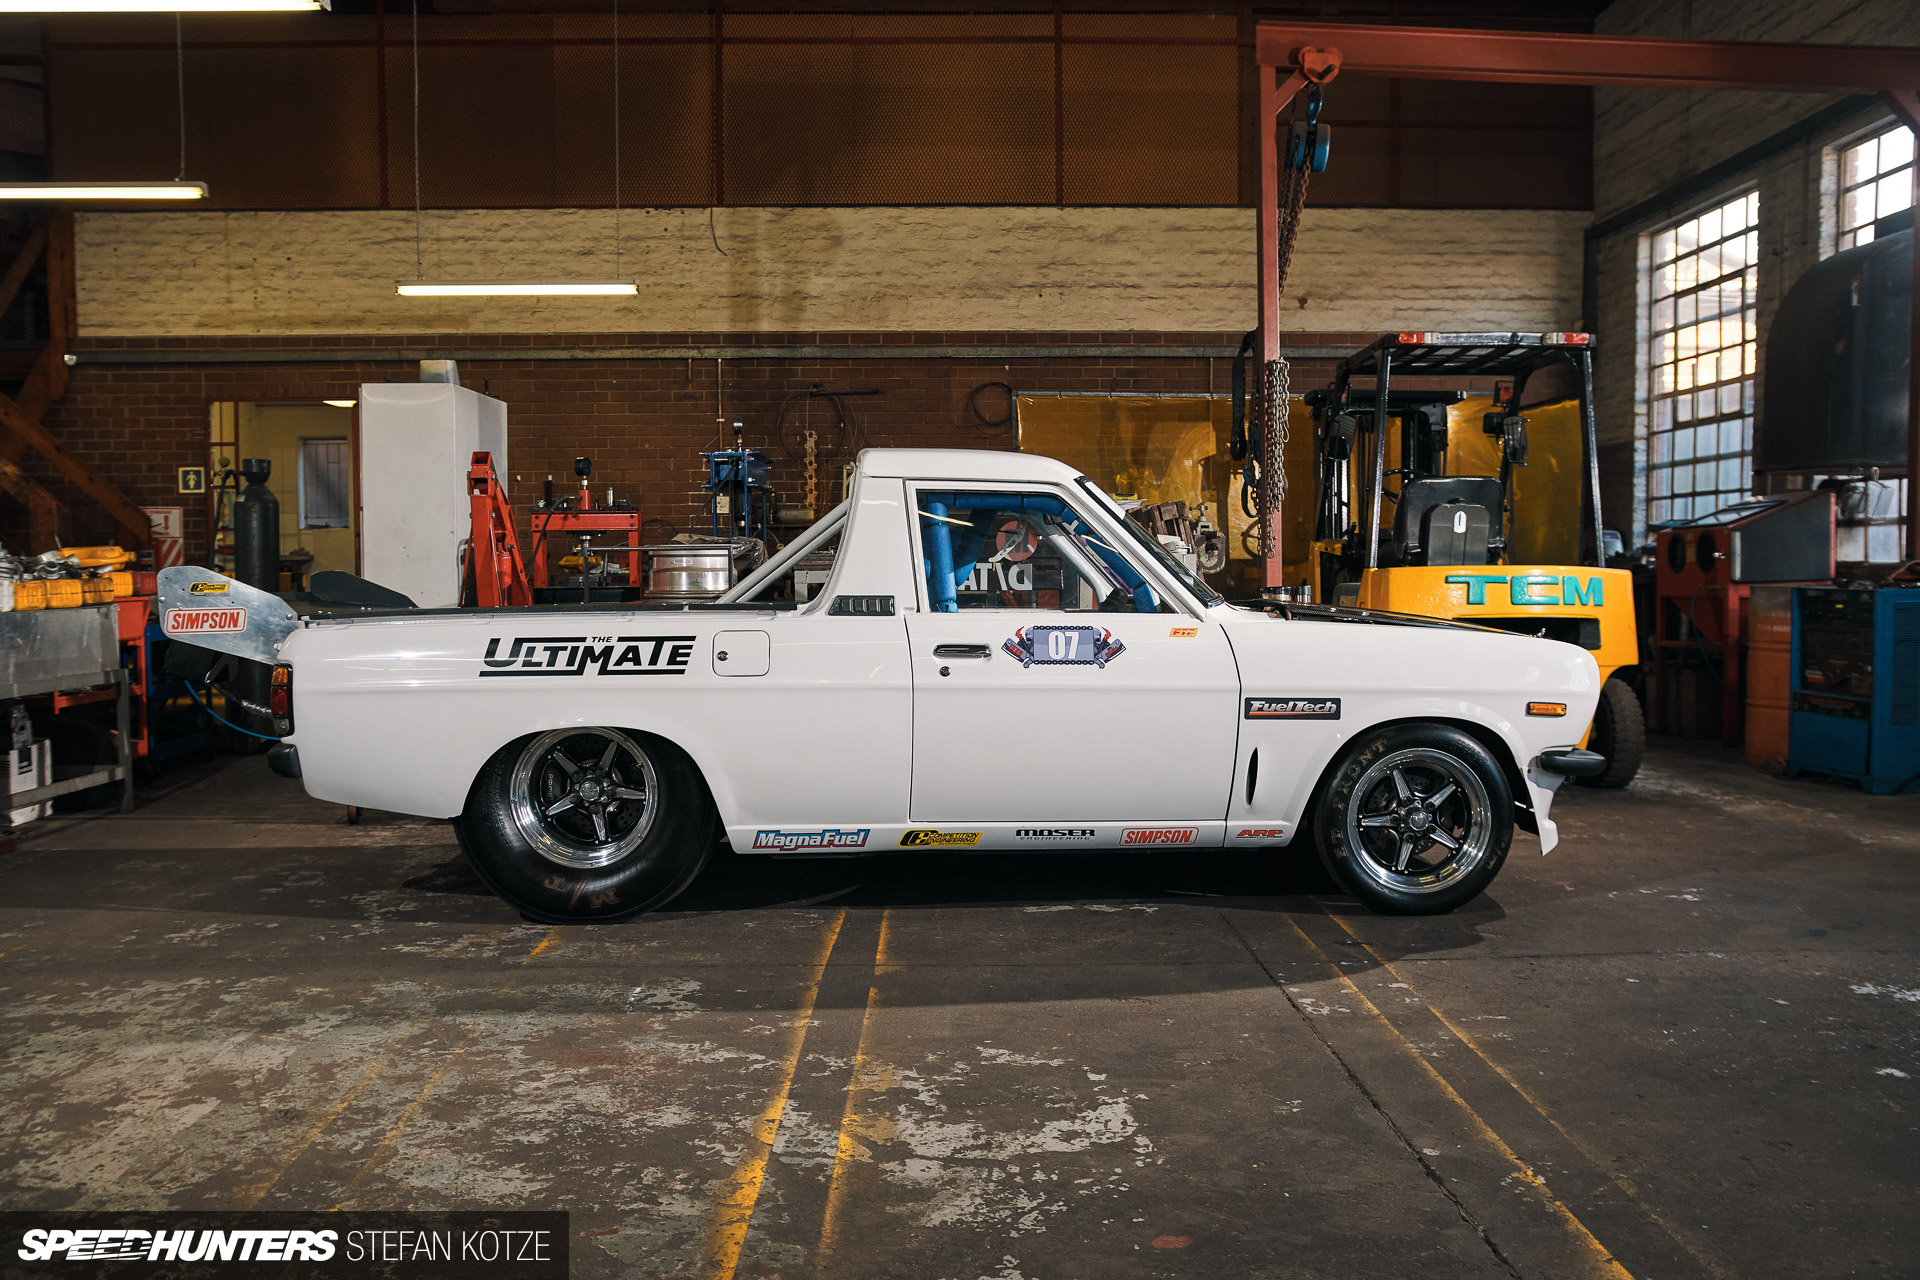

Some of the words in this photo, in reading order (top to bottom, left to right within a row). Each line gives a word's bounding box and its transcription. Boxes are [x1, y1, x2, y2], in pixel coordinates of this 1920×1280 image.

[1446, 575, 1604, 606] TCM
[171, 611, 240, 630] SIMPSON
[1048, 630, 1080, 660] 07
[479, 635, 697, 677] ULTIMATE
[1250, 700, 1337, 714] FuelTech
[756, 831, 866, 849] MagnaFuel
[1124, 829, 1194, 844] SIMPSON
[1236, 829, 1284, 838] ARP
